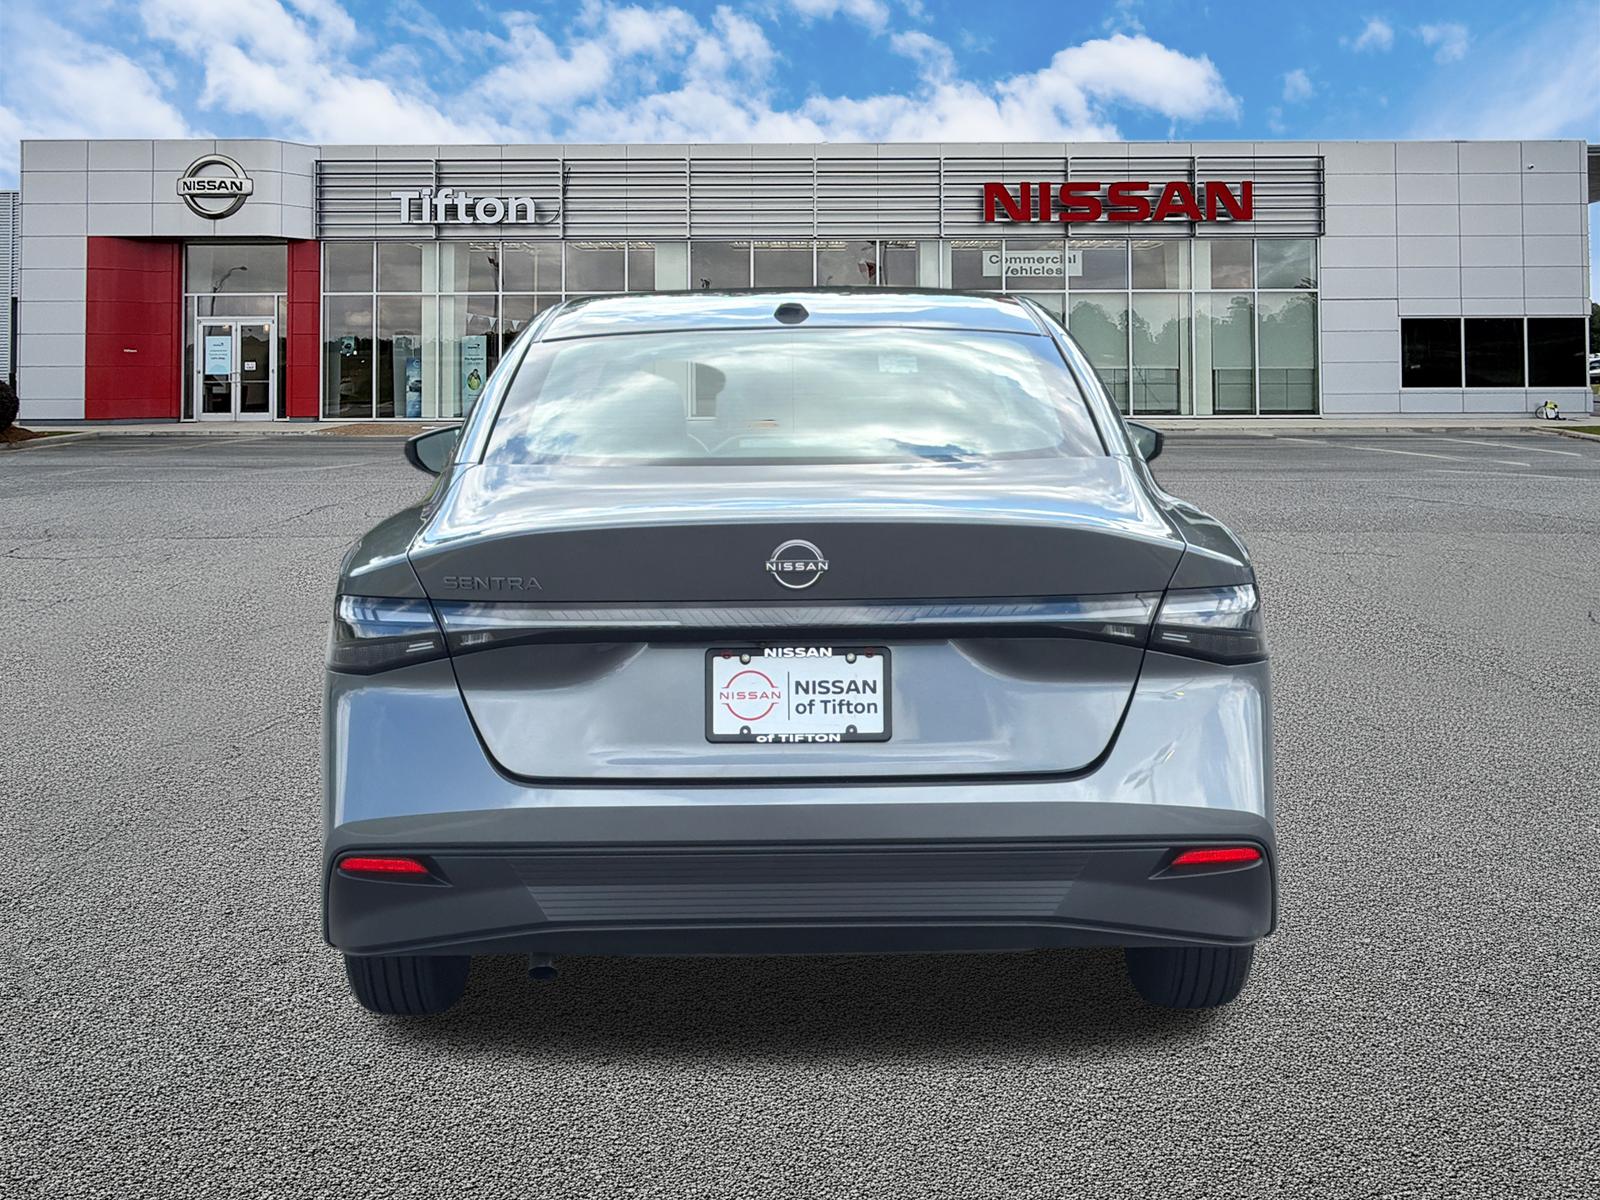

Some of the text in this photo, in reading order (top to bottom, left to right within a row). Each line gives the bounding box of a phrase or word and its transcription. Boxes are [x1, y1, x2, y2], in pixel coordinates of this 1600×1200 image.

[183, 180, 243, 191] NISSAN
[391, 187, 535, 224] Tifton
[984, 181, 1253, 222] NISSAN
[766, 562, 829, 571] NISSAN
[443, 576, 543, 590] SENTRA
[764, 648, 833, 657] NISSAN
[794, 680, 877, 695] NISSAN
[720, 691, 781, 700] NISSAN
[795, 699, 878, 715] of Tifton
[756, 734, 841, 743] of TIFTON
